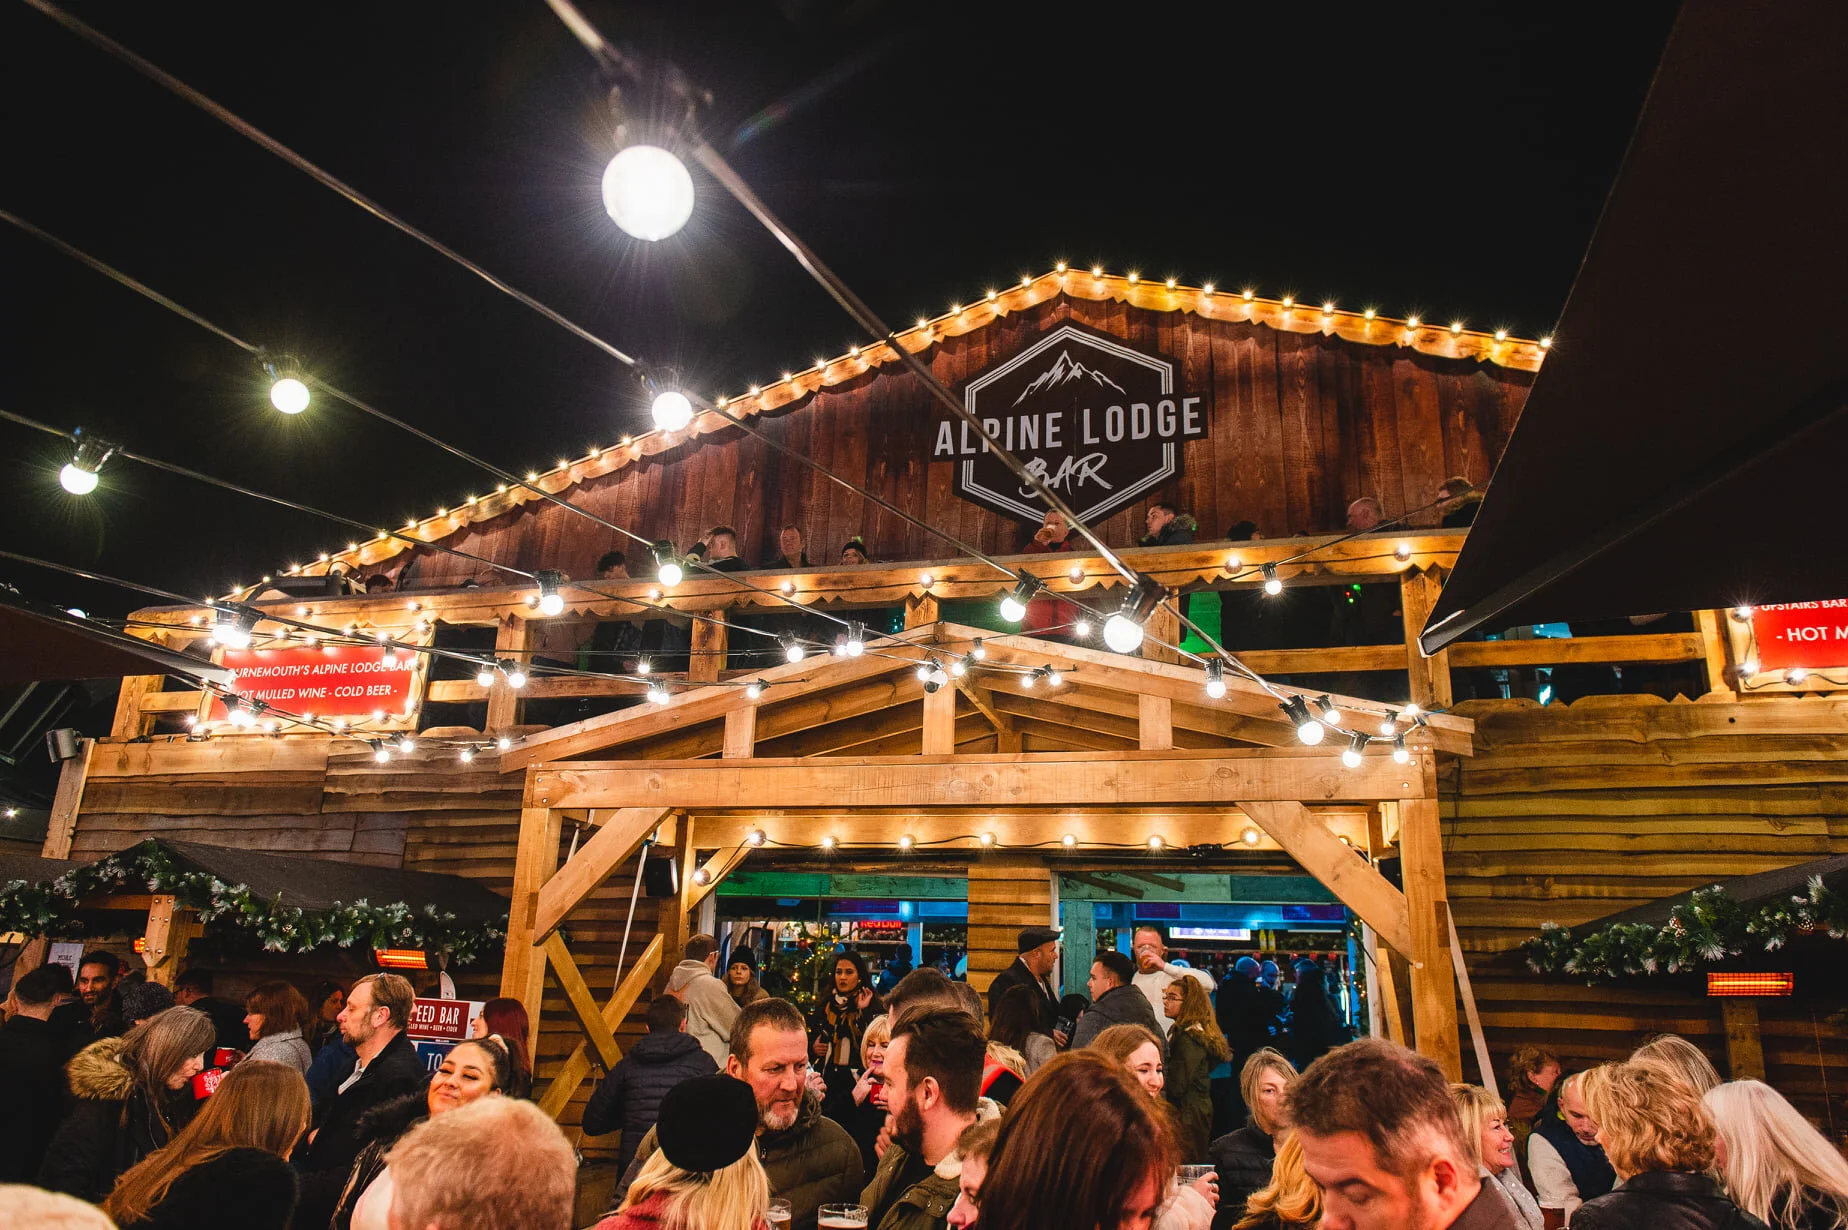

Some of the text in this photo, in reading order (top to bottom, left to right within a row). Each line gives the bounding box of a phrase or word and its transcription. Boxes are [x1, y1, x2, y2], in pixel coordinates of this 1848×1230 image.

[934, 397, 1202, 456] ALPINE LODGE
[1018, 452, 1114, 498] BAR
[1786, 626, 1828, 642] HOT
[234, 664, 310, 678] URNEMOUTH'S
[312, 663, 348, 675] ALPINE
[255, 688, 295, 700] MULLED
[298, 687, 327, 699] WINE
[334, 685, 364, 698] COLD
[366, 684, 391, 696] BEER
[415, 1004, 460, 1025] EED BAR
